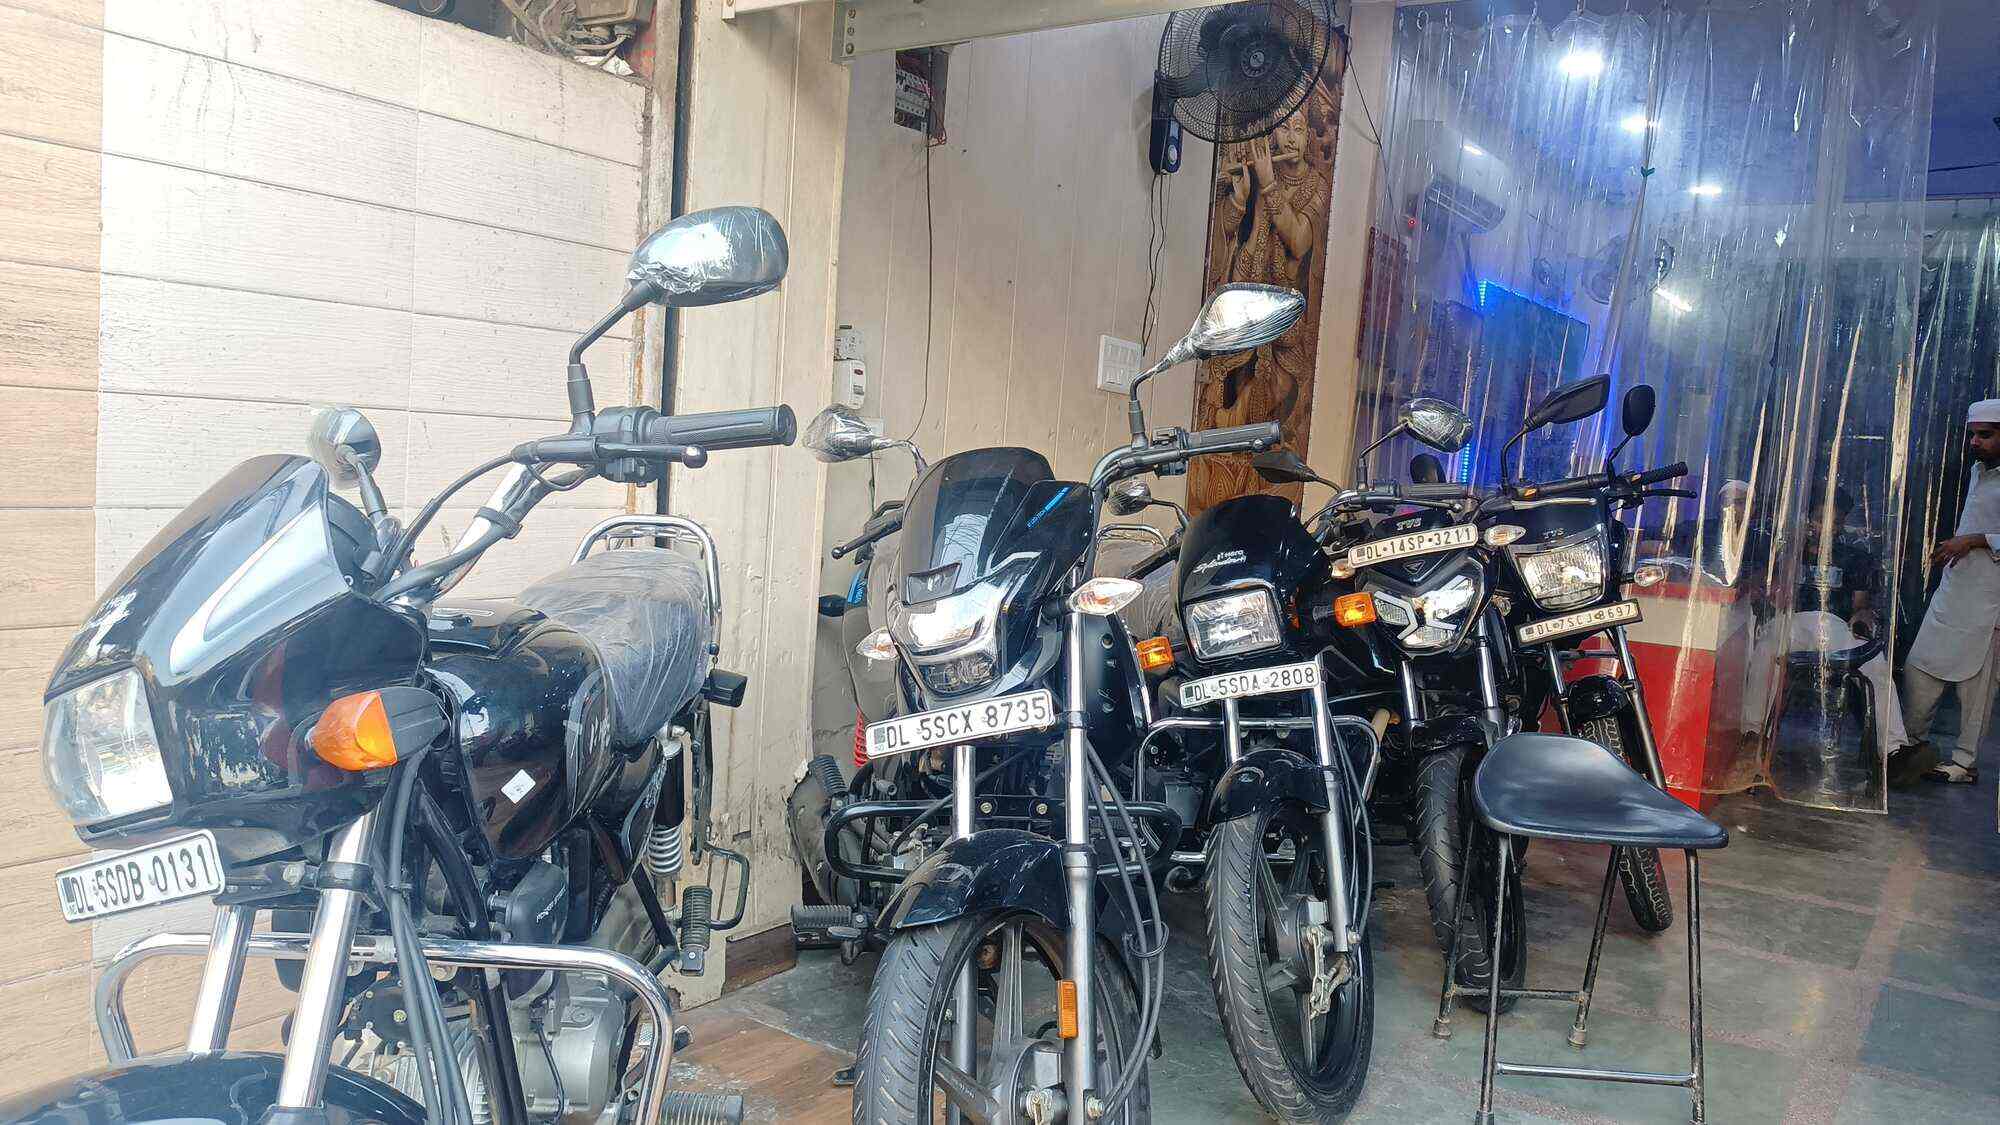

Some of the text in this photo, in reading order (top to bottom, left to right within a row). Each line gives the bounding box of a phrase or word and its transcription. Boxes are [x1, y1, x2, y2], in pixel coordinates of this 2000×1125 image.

[1366, 527, 1471, 560] DL 14SP 3211
[1536, 624, 1552, 635] DL
[1194, 667, 1315, 701] DL 5SDA 2808
[886, 696, 1047, 749] DL 5SCX 8735
[71, 844, 214, 914] DL 5SDB 0131
